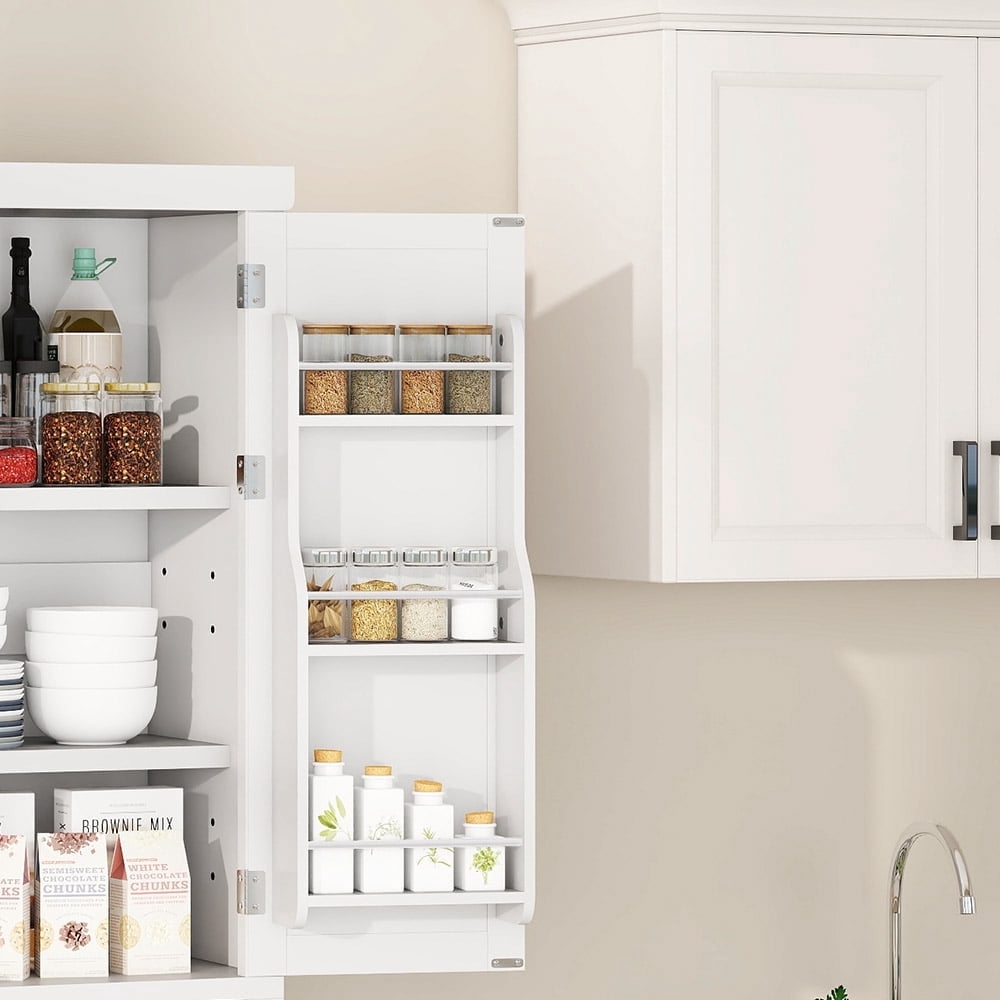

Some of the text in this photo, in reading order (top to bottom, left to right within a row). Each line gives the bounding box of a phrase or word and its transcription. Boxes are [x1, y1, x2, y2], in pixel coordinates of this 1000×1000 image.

[82, 817, 173, 834] BROWNIE MIX
[42, 867, 105, 875] SEMISWEET
[128, 863, 168, 872] WHITE
[129, 872, 188, 880] CHOCOLATE
[43, 884, 106, 894] CHUNKS
[130, 881, 189, 891] CHUNKS
